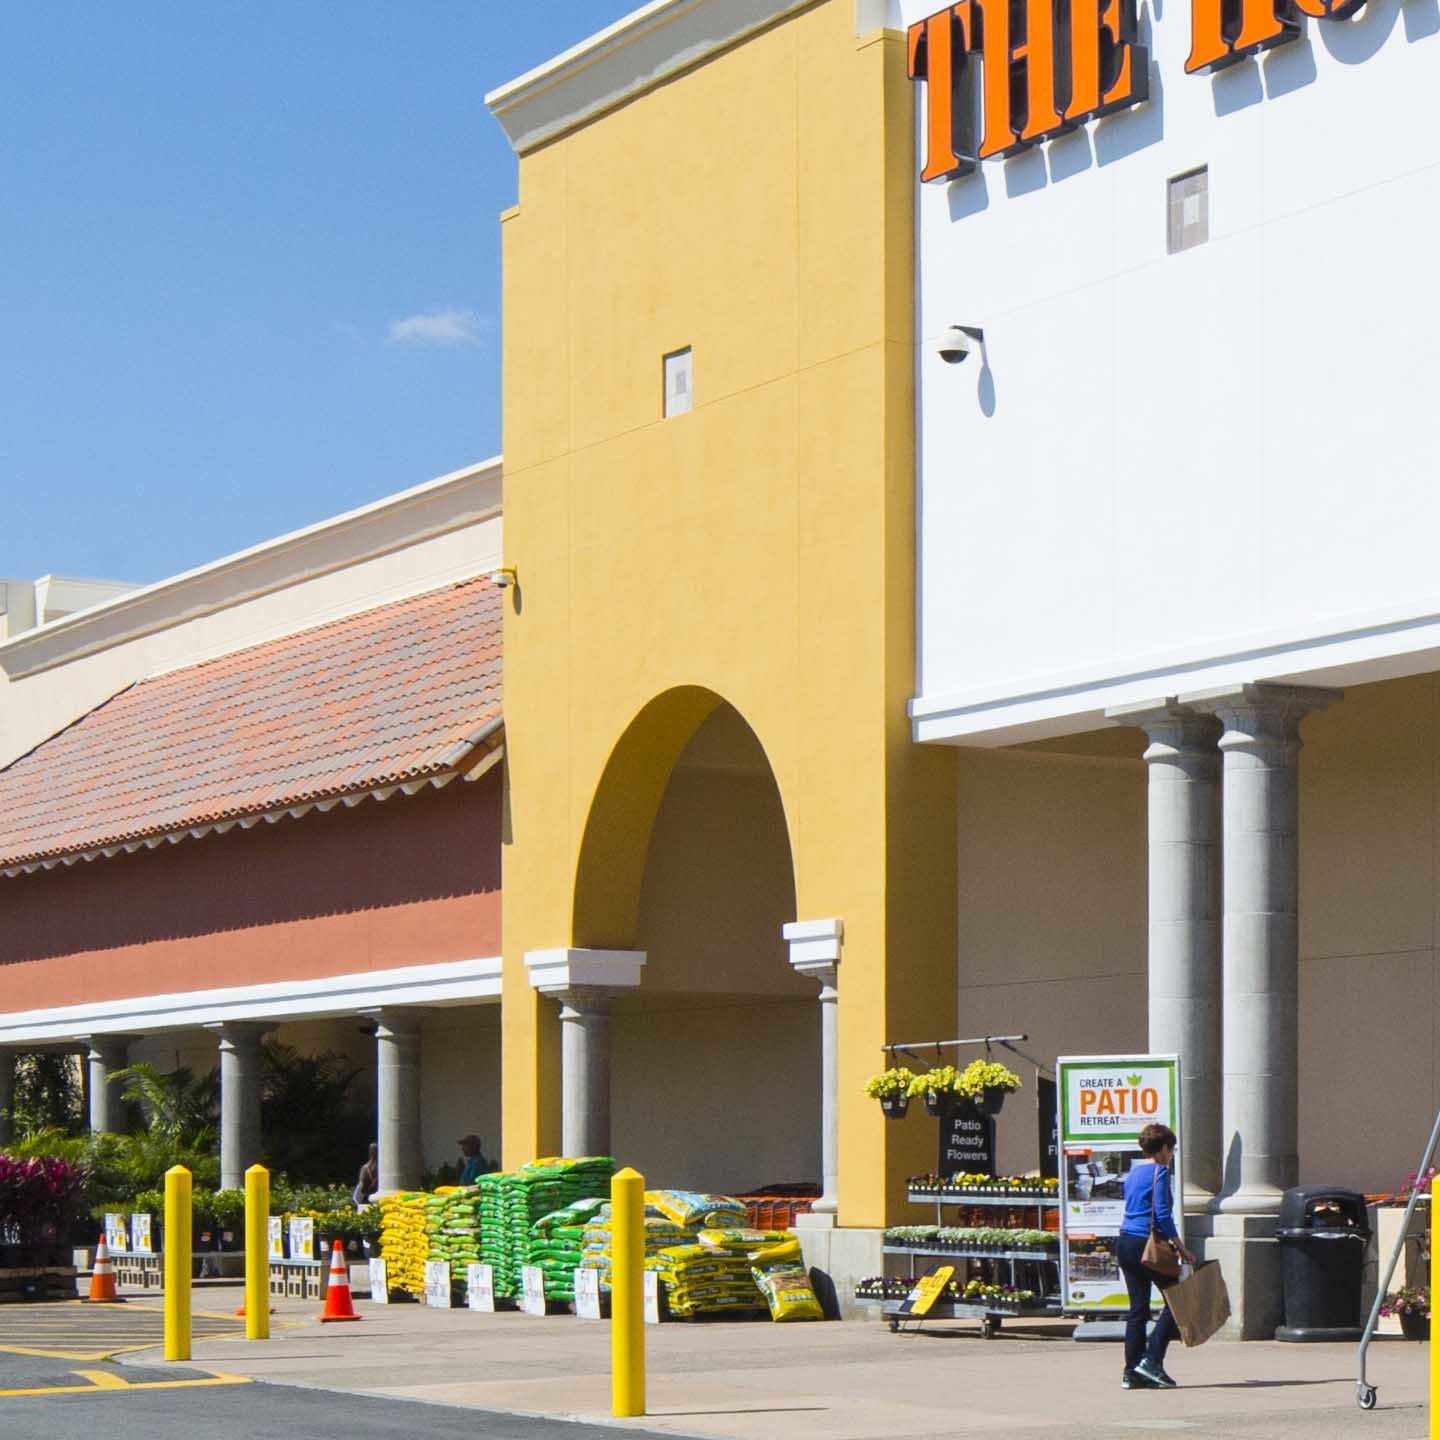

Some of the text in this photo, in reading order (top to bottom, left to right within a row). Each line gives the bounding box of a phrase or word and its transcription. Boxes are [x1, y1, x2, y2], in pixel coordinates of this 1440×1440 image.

[1080, 1078, 1123, 1088] CREATE A
[1080, 1087, 1159, 1115] PATIO
[954, 1119, 981, 1130] Patio
[1080, 1116, 1120, 1126] RETREAT
[951, 1134, 984, 1147] Ready
[947, 1149, 988, 1160] Flowers
